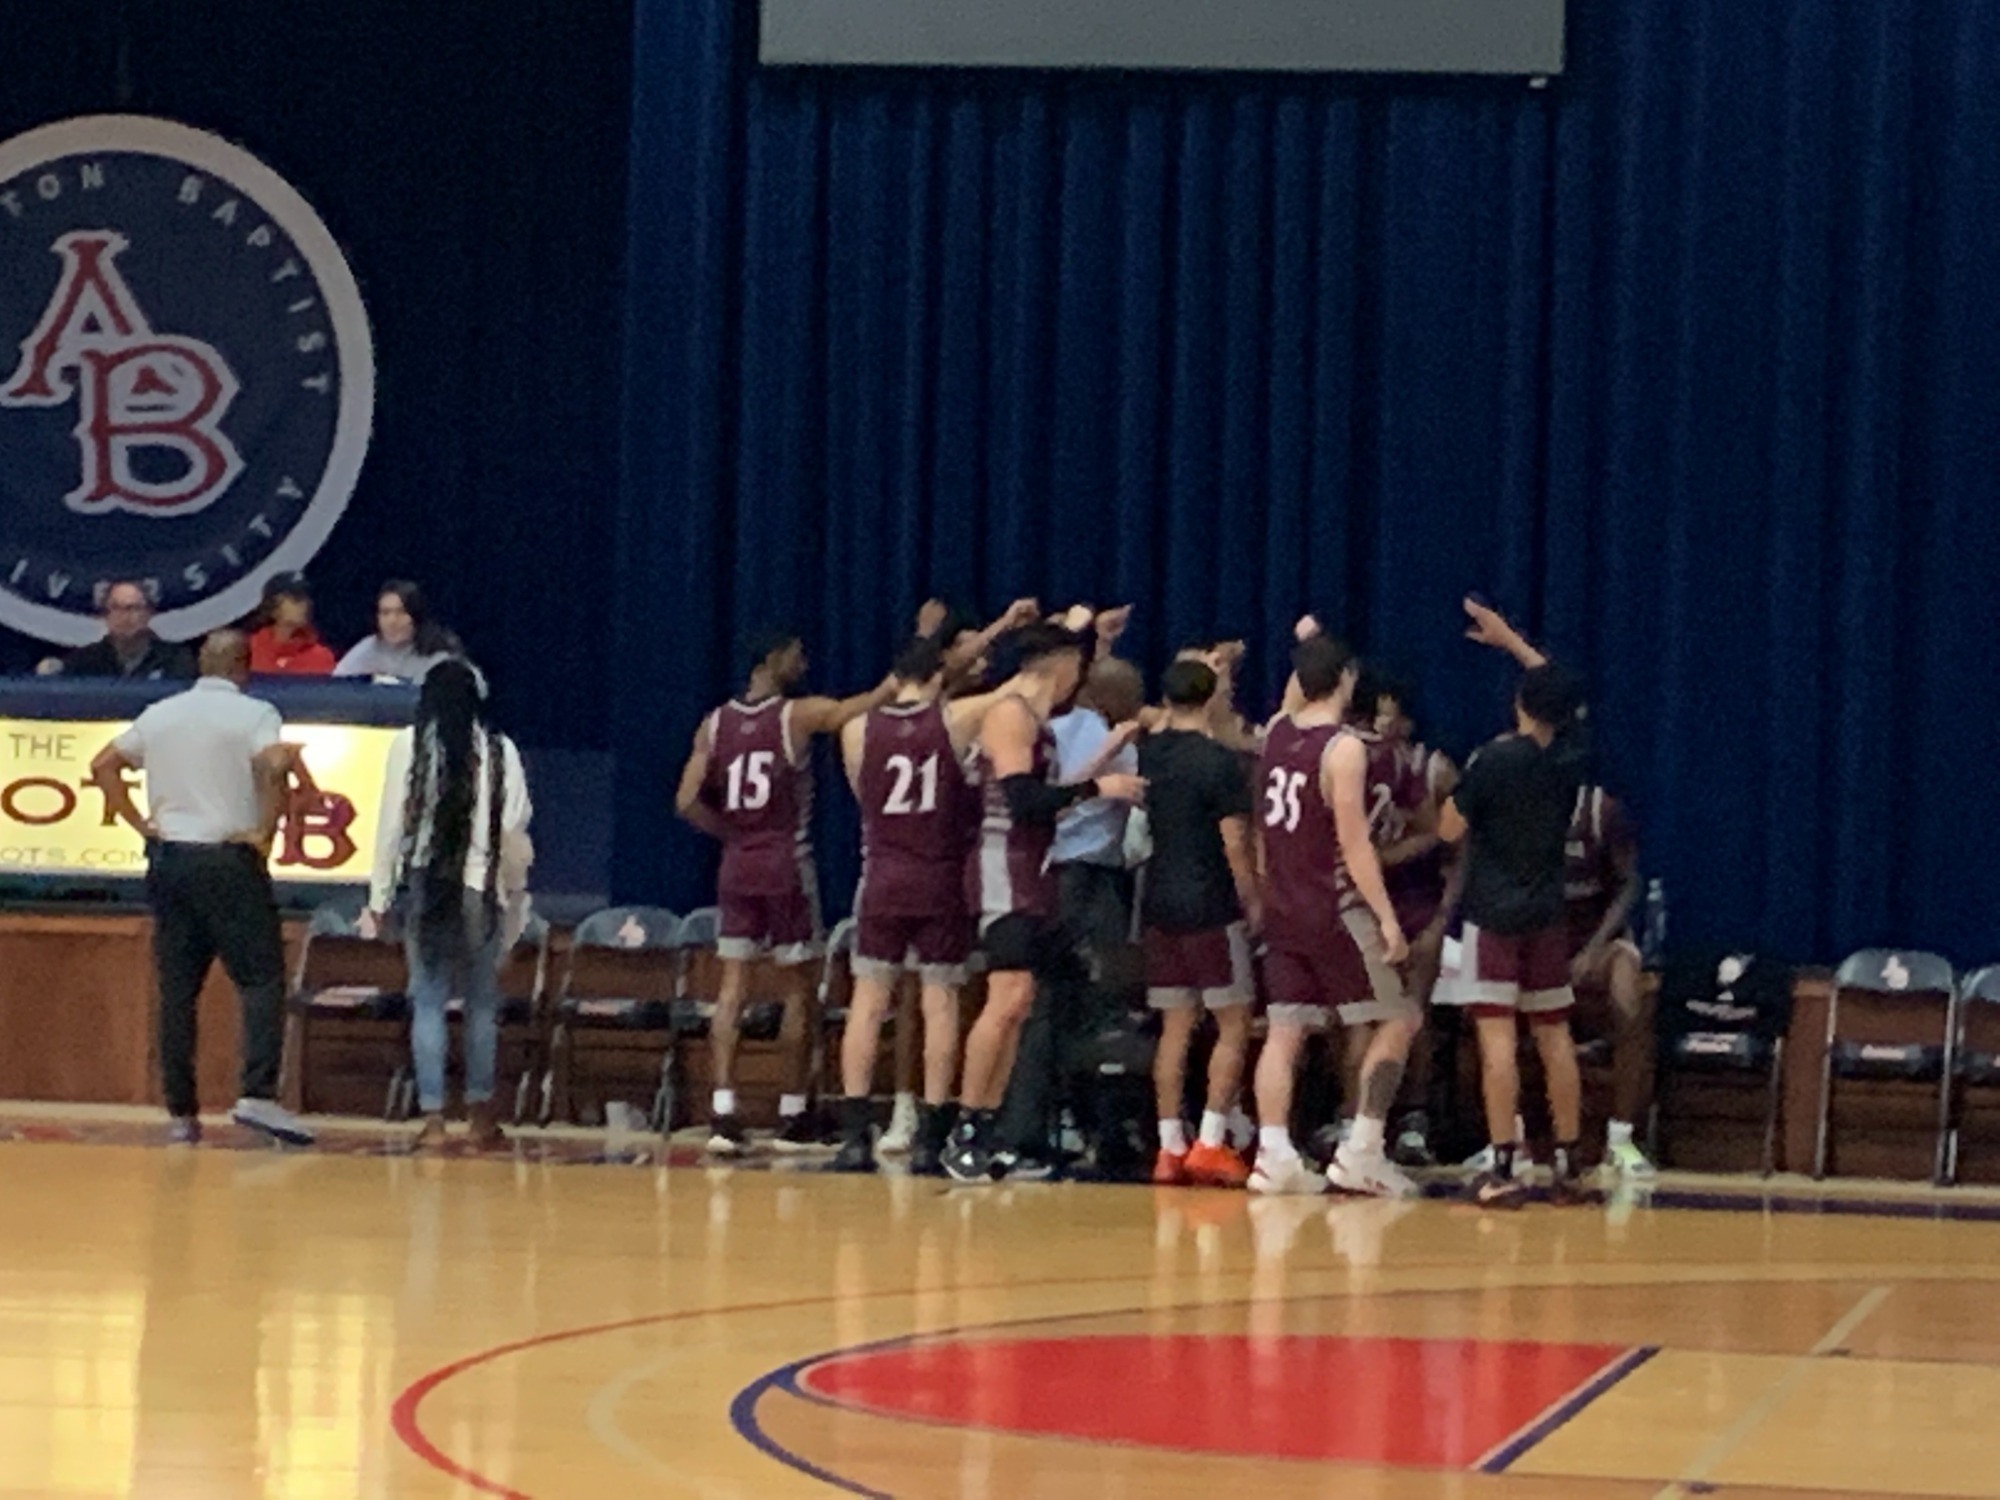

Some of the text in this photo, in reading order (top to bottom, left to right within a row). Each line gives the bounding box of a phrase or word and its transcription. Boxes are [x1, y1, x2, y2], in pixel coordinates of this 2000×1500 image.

[177, 174, 331, 395] BAPTIST
[0, 229, 247, 518] AB
[8, 733, 77, 761] THE
[726, 751, 775, 811] 15
[882, 754, 940, 815] 21
[1264, 766, 1308, 833] 35
